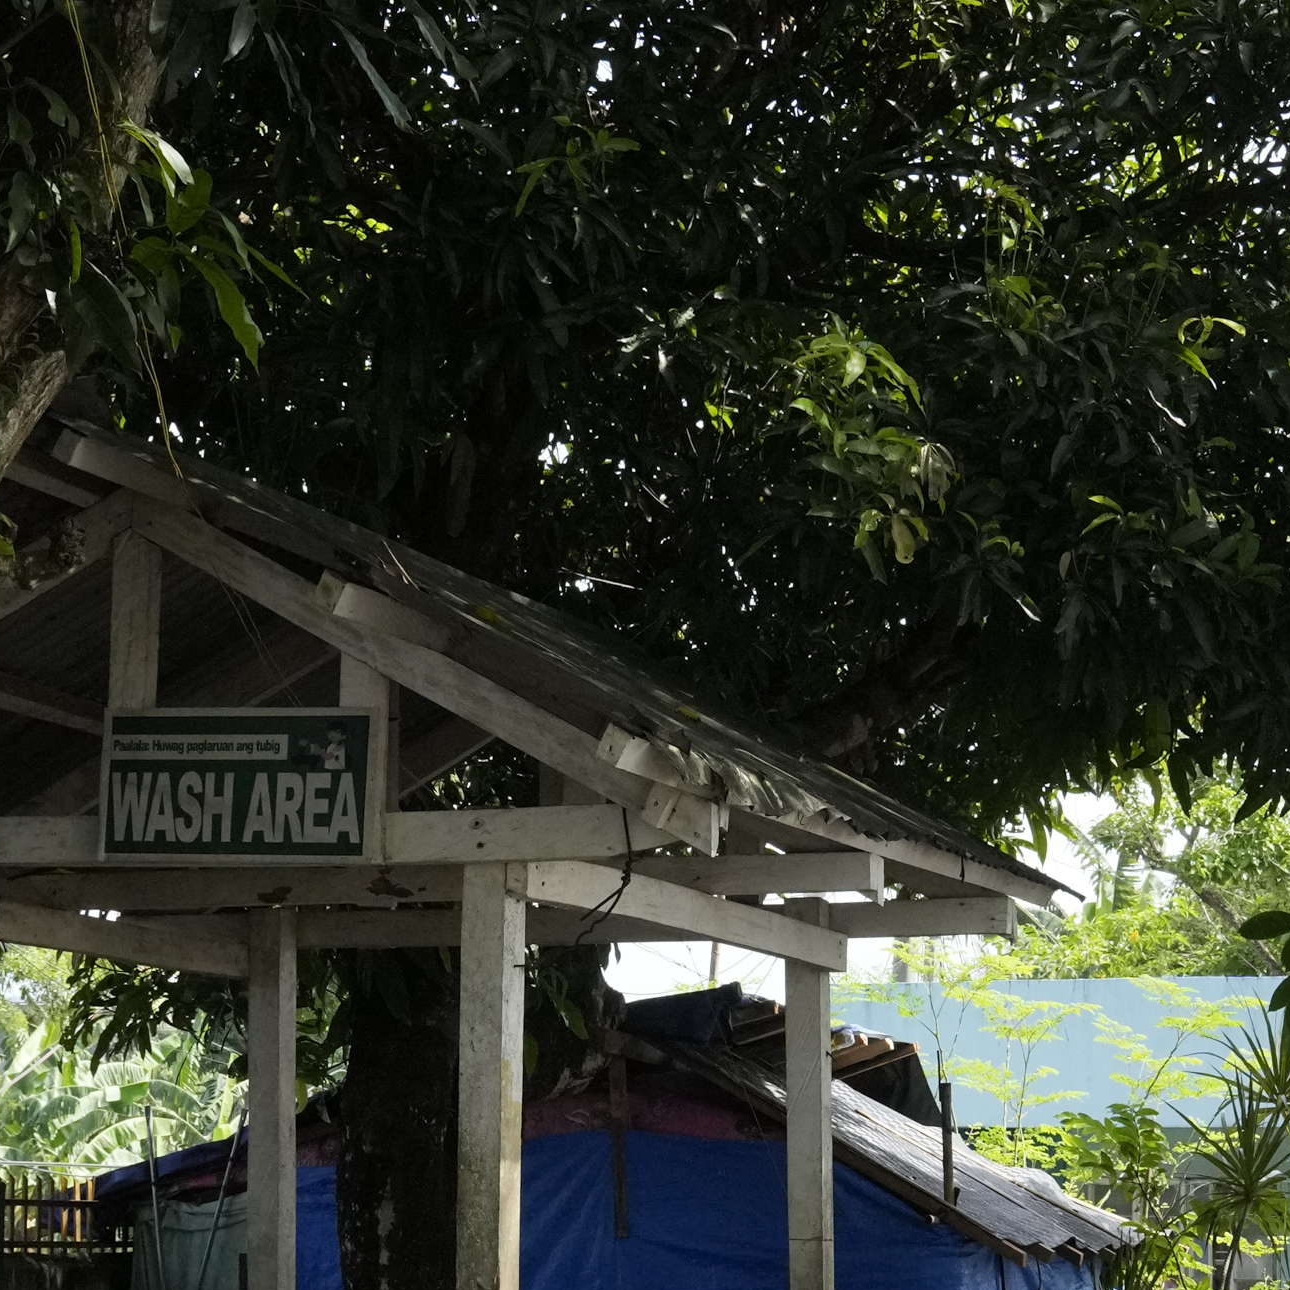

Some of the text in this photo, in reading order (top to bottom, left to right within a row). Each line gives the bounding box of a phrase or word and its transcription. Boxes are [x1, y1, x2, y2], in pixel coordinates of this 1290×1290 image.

[152, 739, 184, 754] Huwag
[186, 740, 234, 754] paglaruan
[236, 741, 254, 754] ang
[256, 740, 281, 754] tubig
[111, 770, 361, 844] WASH AREA
